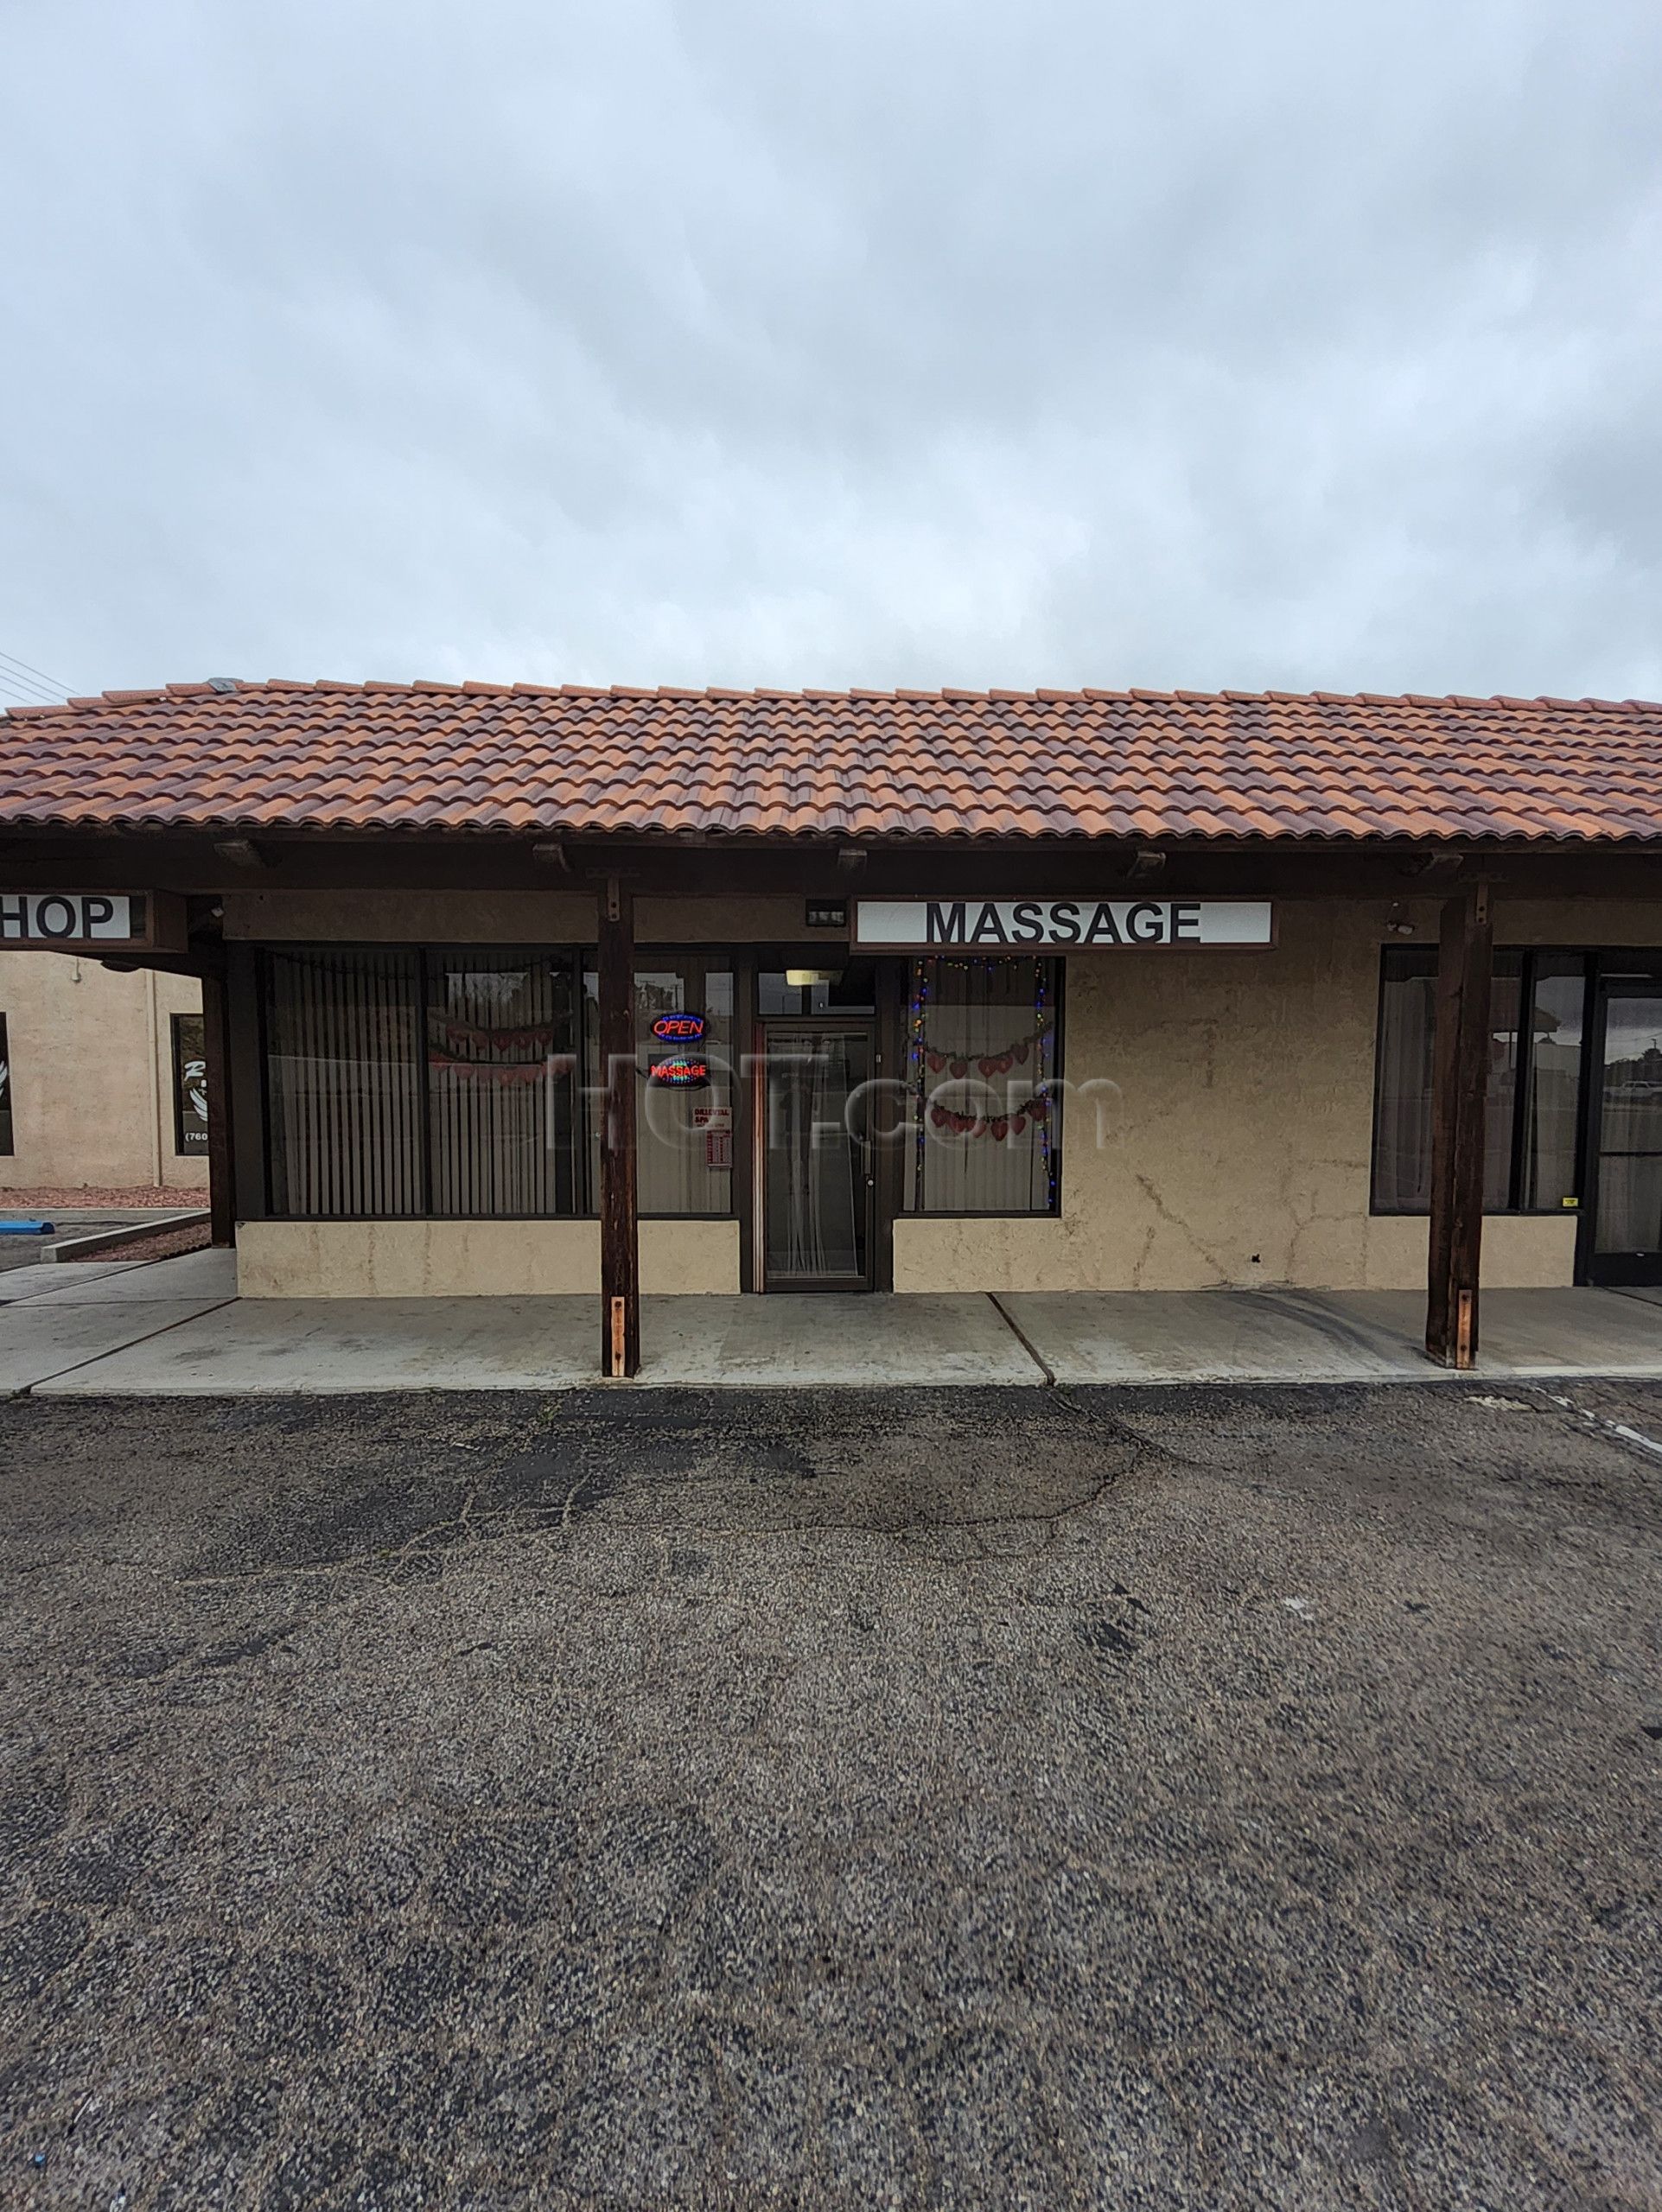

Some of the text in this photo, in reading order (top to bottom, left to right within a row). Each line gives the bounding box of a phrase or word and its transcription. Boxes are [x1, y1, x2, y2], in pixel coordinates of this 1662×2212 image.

[0, 895, 114, 938] HOP
[927, 902, 1200, 944] MASSAGE
[653, 1020, 704, 1034] OPEN
[651, 1065, 706, 1077] MASSAGE
